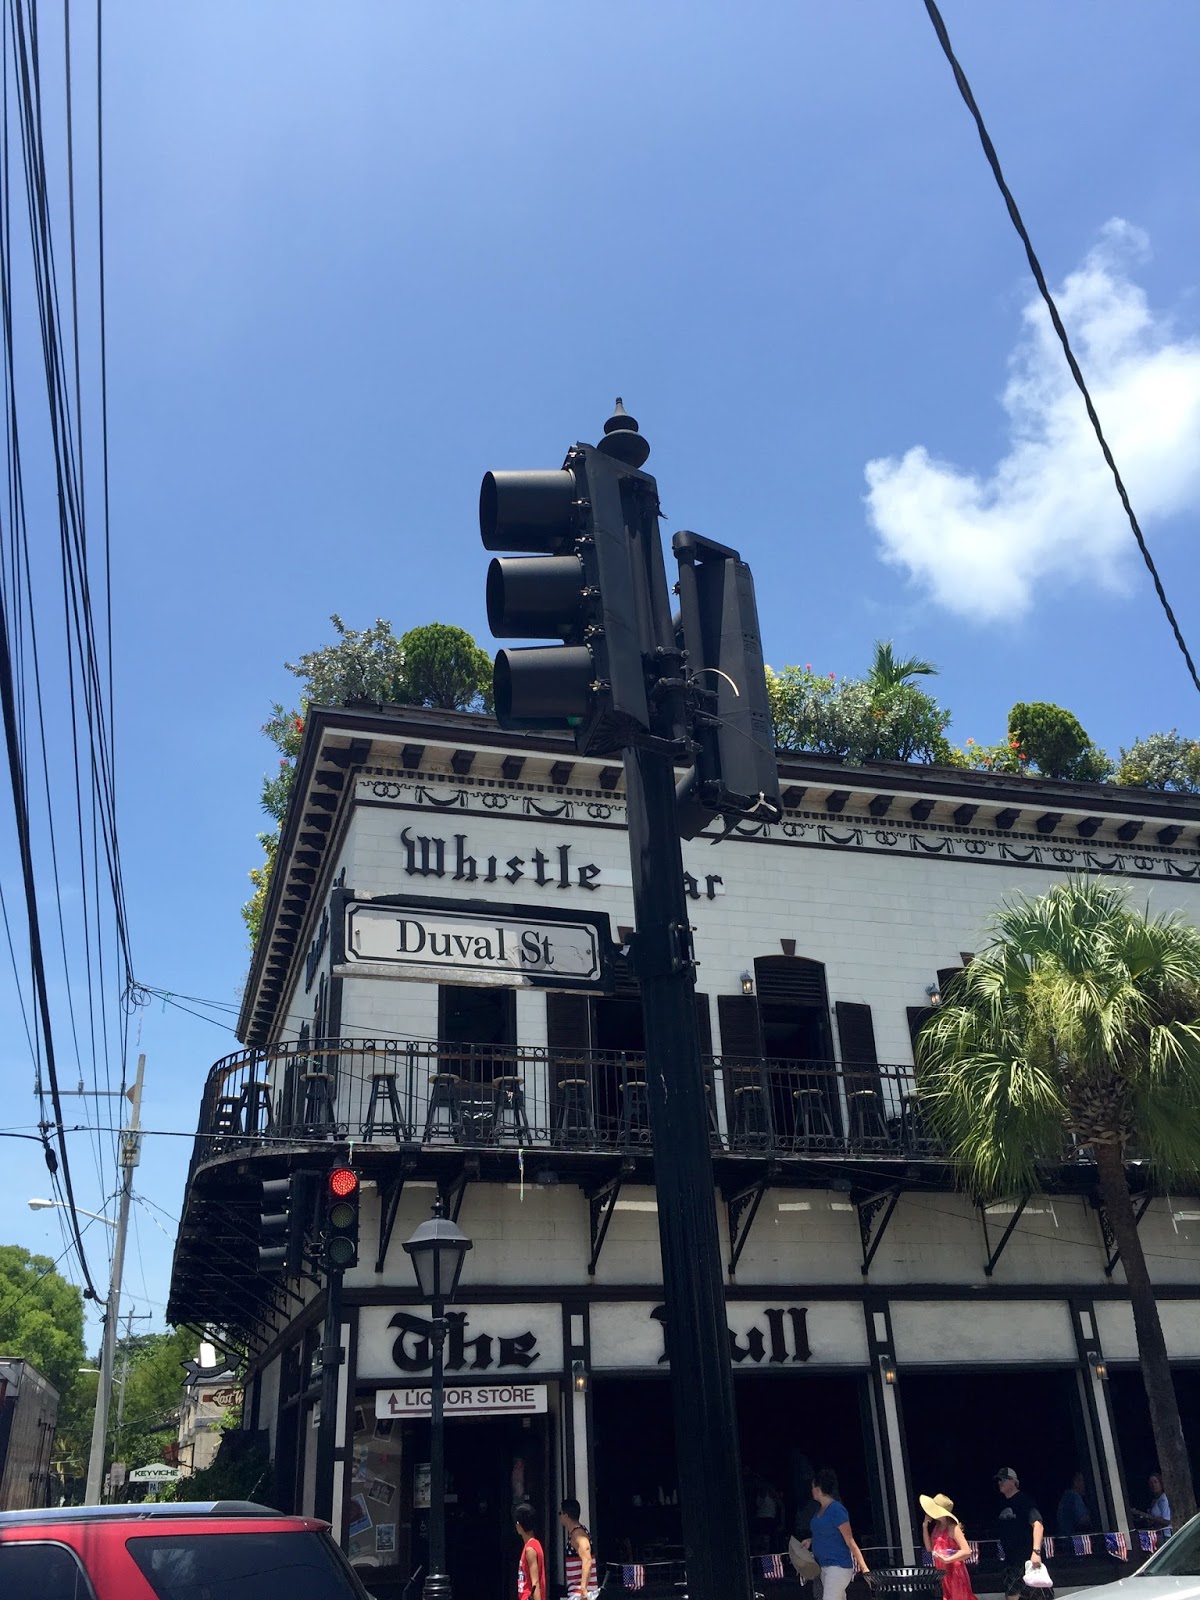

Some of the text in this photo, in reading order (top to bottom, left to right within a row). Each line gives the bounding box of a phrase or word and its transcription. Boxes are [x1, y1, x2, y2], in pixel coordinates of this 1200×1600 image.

[400, 826, 724, 901] Whistle ar
[396, 919, 555, 965] Duval St
[387, 1312, 541, 1372] The
[477, 1387, 535, 1404] STORE
[134, 1469, 179, 1478] KEYVICHE
